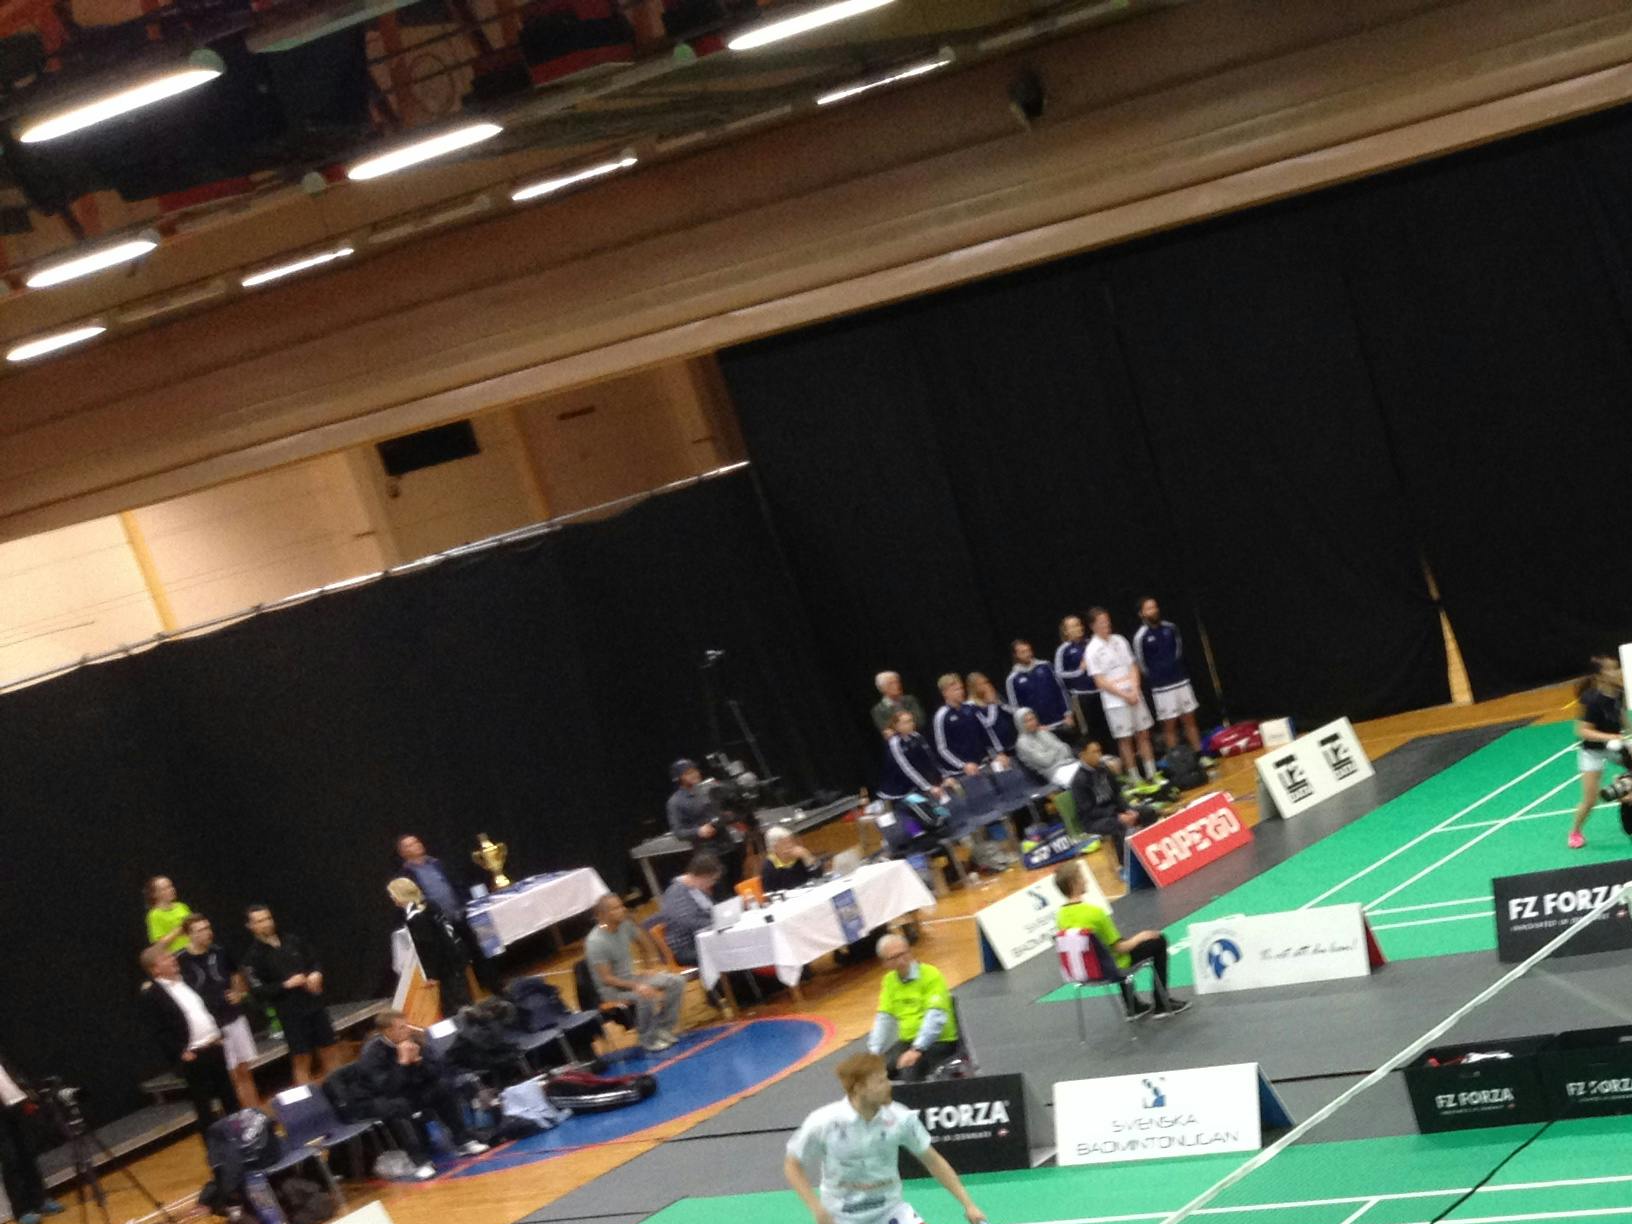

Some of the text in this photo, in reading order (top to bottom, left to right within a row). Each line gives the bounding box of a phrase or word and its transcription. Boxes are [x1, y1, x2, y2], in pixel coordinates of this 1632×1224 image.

[1508, 896, 1540, 920] FZ
[1435, 1088, 1514, 1109] FZ FORZA
[1566, 1081, 1587, 1096] FZ
[925, 1101, 1010, 1130] FORZA
[1112, 1114, 1198, 1133] SVENSKA
